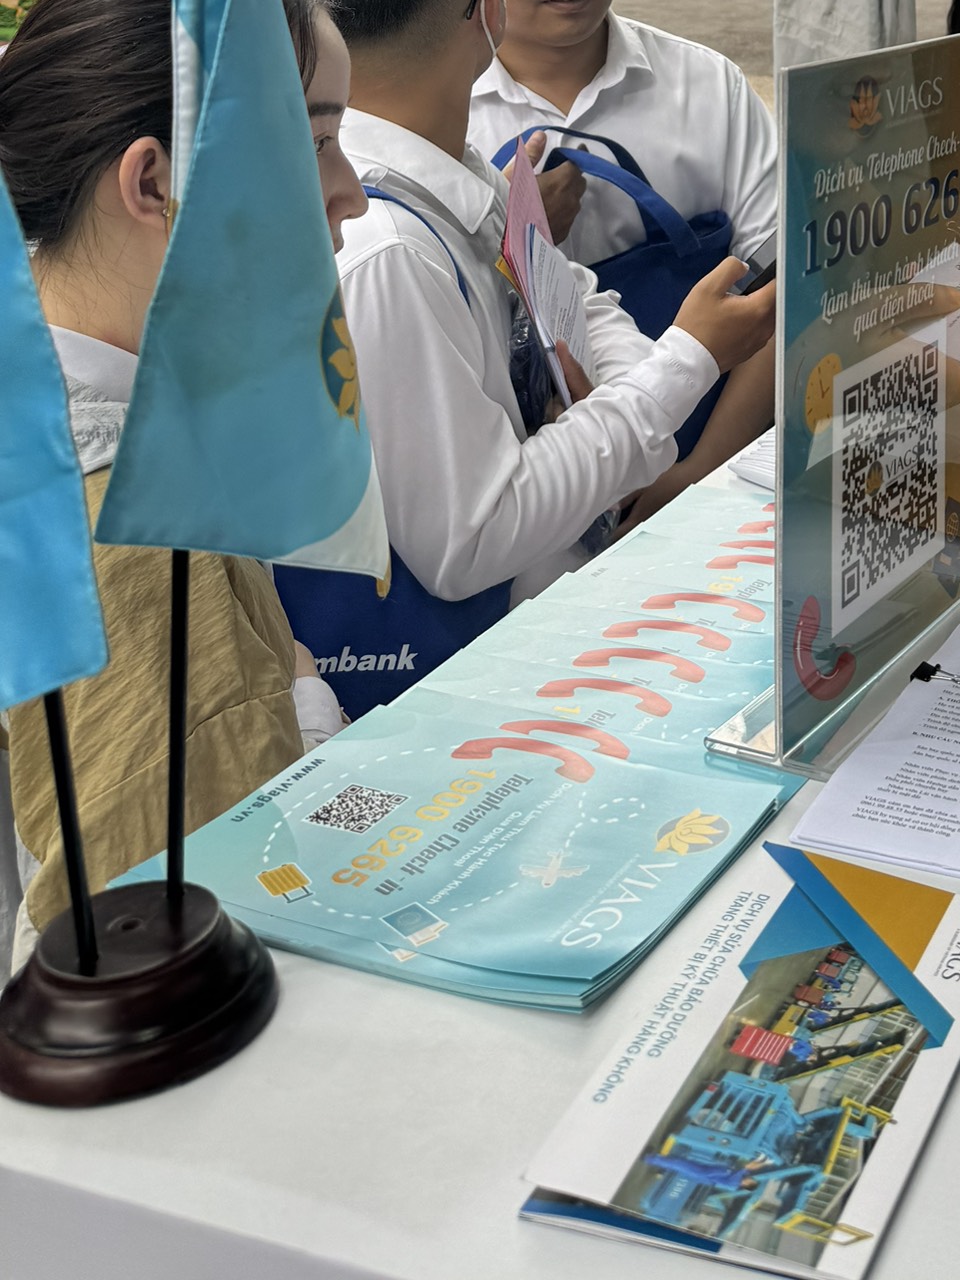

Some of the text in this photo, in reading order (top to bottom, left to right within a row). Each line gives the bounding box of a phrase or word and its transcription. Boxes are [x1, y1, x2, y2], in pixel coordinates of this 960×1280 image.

[887, 76, 944, 118] VIAGS
[814, 166, 846, 202] Dịch
[848, 166, 864, 192] vụ
[866, 146, 925, 183] Telephone
[802, 193, 893, 276] 1900
[820, 235, 960, 324] Làm thủ tục hành khách
[853, 307, 878, 344] qua
[880, 289, 905, 325] điện
[907, 274, 936, 307] thoại
[885, 447, 919, 479] VIAGS
[314, 643, 418, 674] mbank
[229, 758, 327, 823] www.viags.vn
[441, 773, 536, 834] Telephone
[497, 810, 525, 827] Qua
[330, 766, 499, 889] 1900 6265
[395, 833, 466, 876] Check
[424, 879, 464, 906] Khách
[453, 857, 489, 880] Hành
[560, 857, 679, 951] VIAGS
[589, 888, 753, 1105] TRANG THIẾT BỊ KỸ THUẬT HÀNG KHÔNG
[645, 892, 770, 1059] DỊCH VỤ SỬA CHỮA BẢO DƯỠNG
